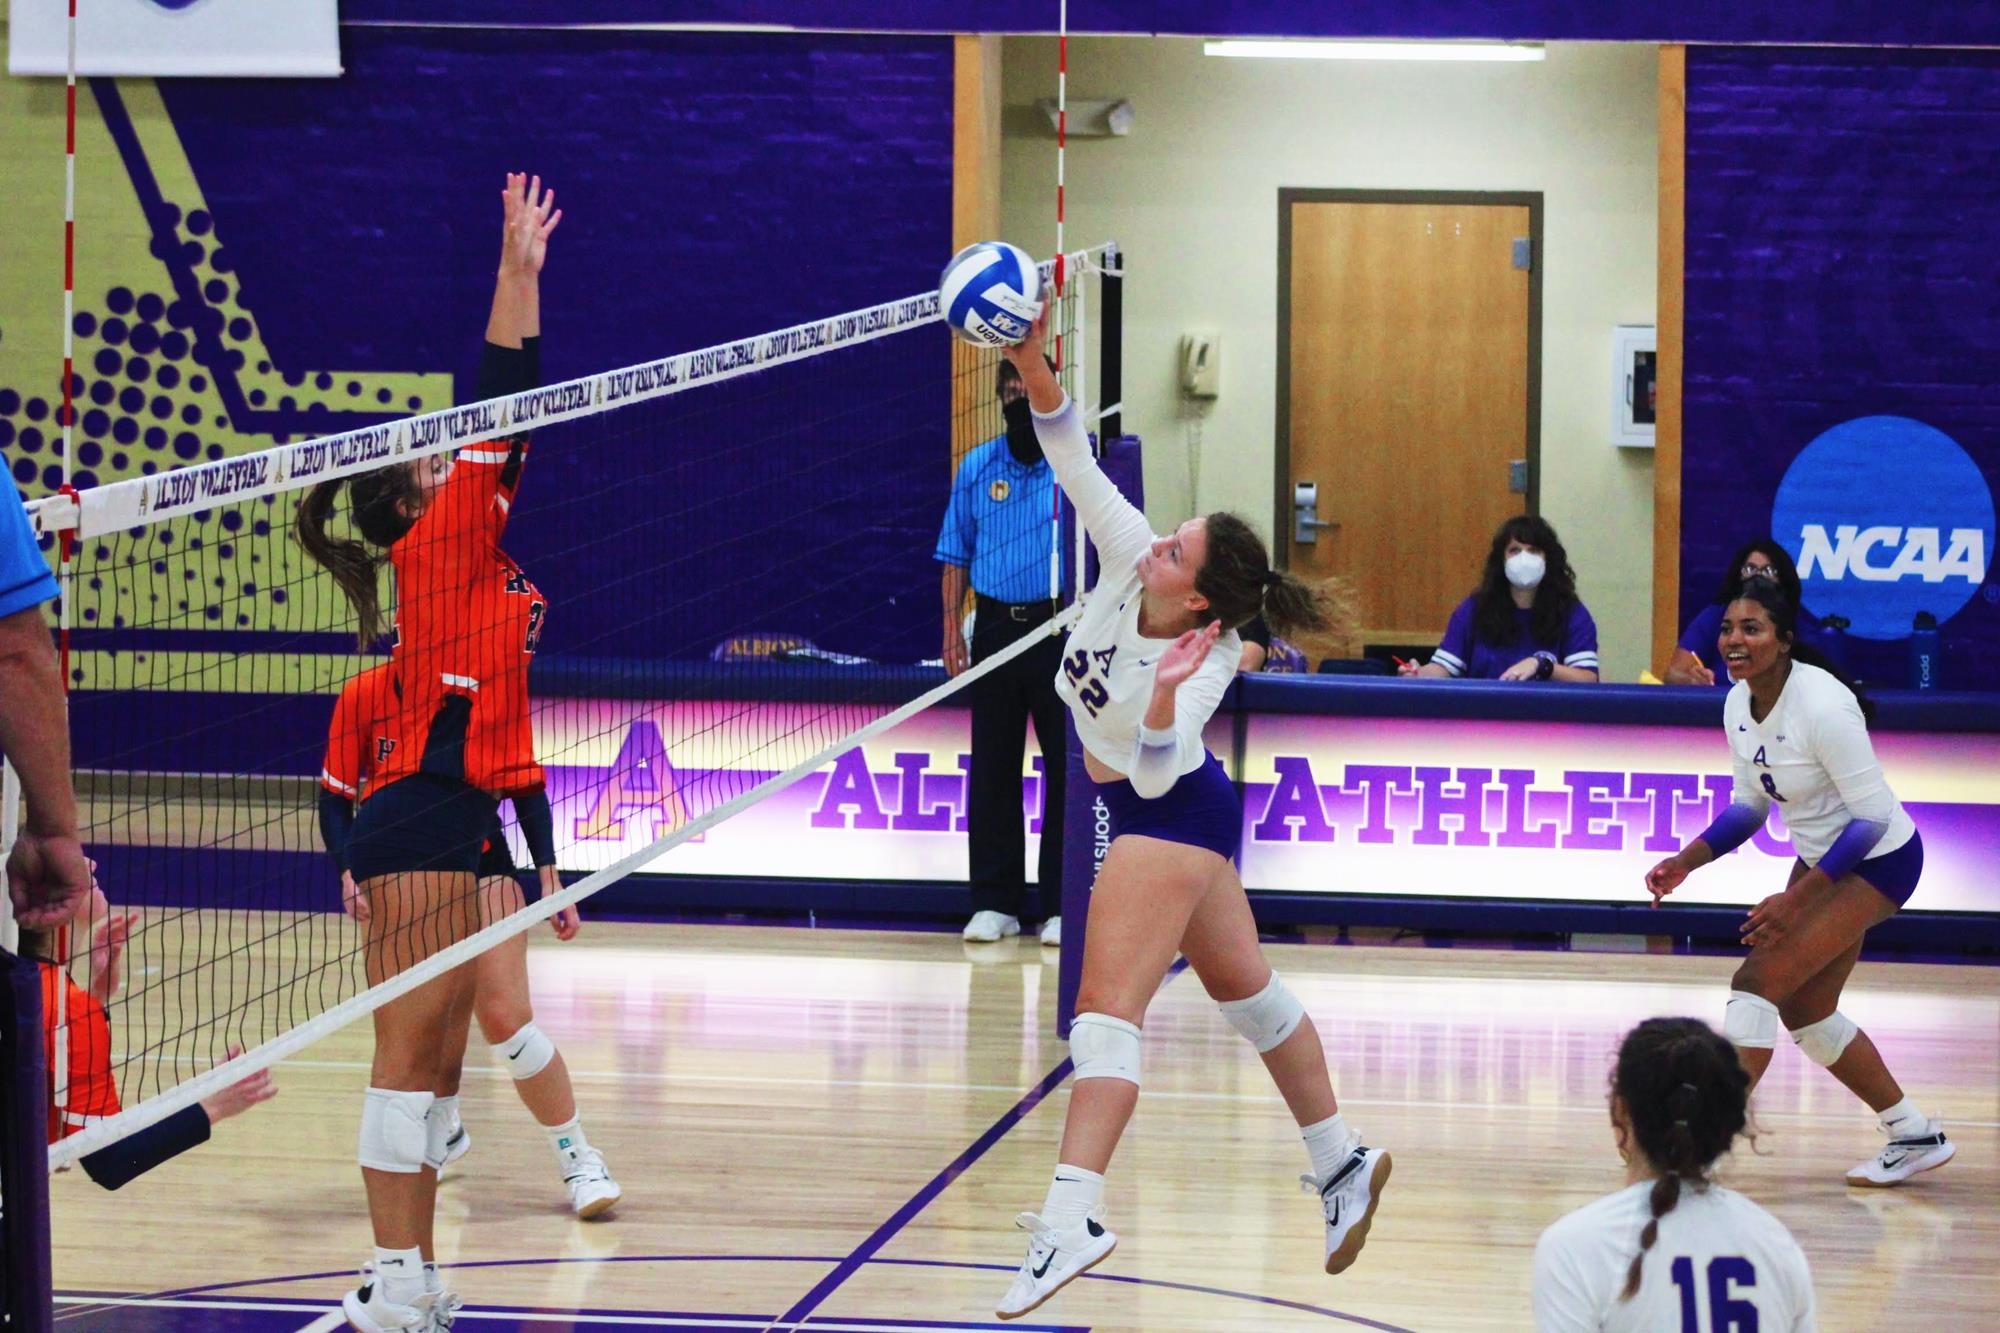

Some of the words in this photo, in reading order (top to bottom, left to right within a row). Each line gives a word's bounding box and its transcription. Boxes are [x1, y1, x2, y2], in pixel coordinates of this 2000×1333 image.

[1797, 524, 1985, 584] NCAA
[1063, 649, 1109, 719] 22
[1753, 745, 1771, 768] A
[1670, 1256, 1760, 1333] 16
